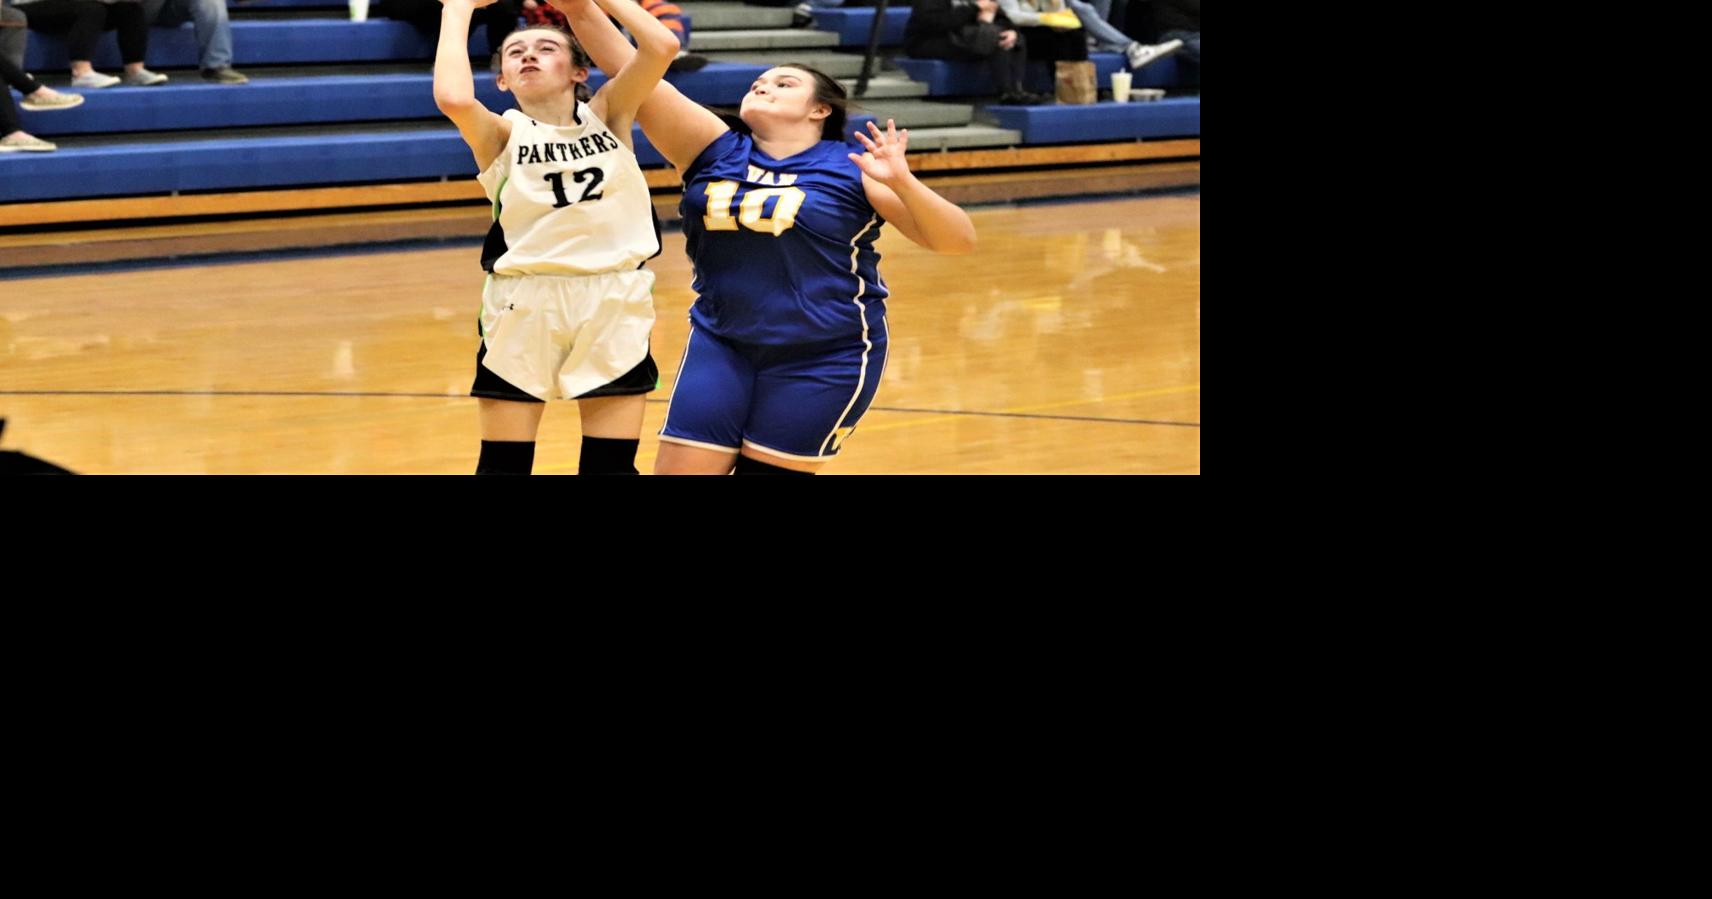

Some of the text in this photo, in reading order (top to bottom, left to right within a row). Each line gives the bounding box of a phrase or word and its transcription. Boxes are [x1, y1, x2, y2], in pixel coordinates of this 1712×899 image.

[516, 131, 619, 165] PANTHERS
[543, 166, 605, 208] 12
[703, 180, 806, 237] 10
